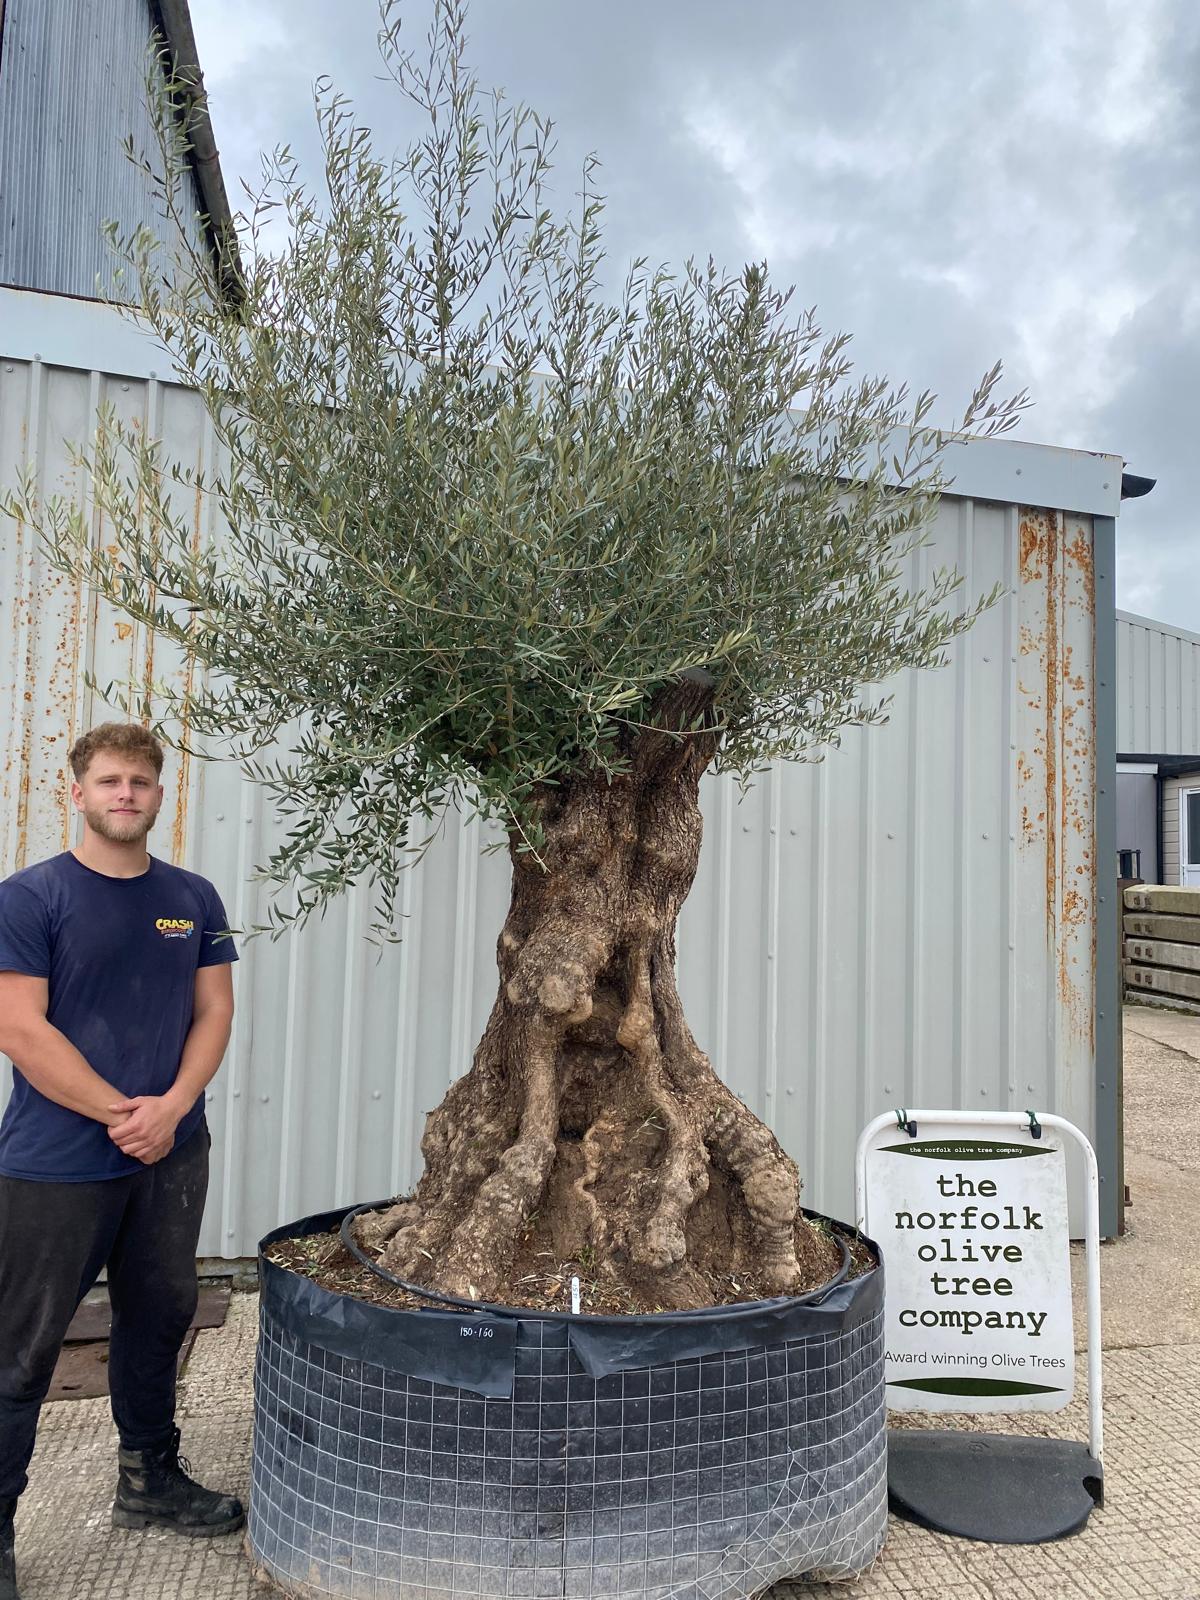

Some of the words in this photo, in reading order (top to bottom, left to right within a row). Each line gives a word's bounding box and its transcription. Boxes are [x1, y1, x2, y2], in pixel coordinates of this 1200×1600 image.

[155, 918, 194, 931] CRASH
[996, 1147, 1023, 1155] company
[936, 1174, 997, 1198] the
[895, 1206, 1044, 1230] norfolk
[917, 1238, 1023, 1263] olive
[930, 1272, 1013, 1296] tree
[898, 1309, 1048, 1337] company
[884, 1350, 927, 1364] Award
[931, 1352, 987, 1368] winning
[991, 1353, 1026, 1367] Olive
[1029, 1354, 1066, 1368] Trees
